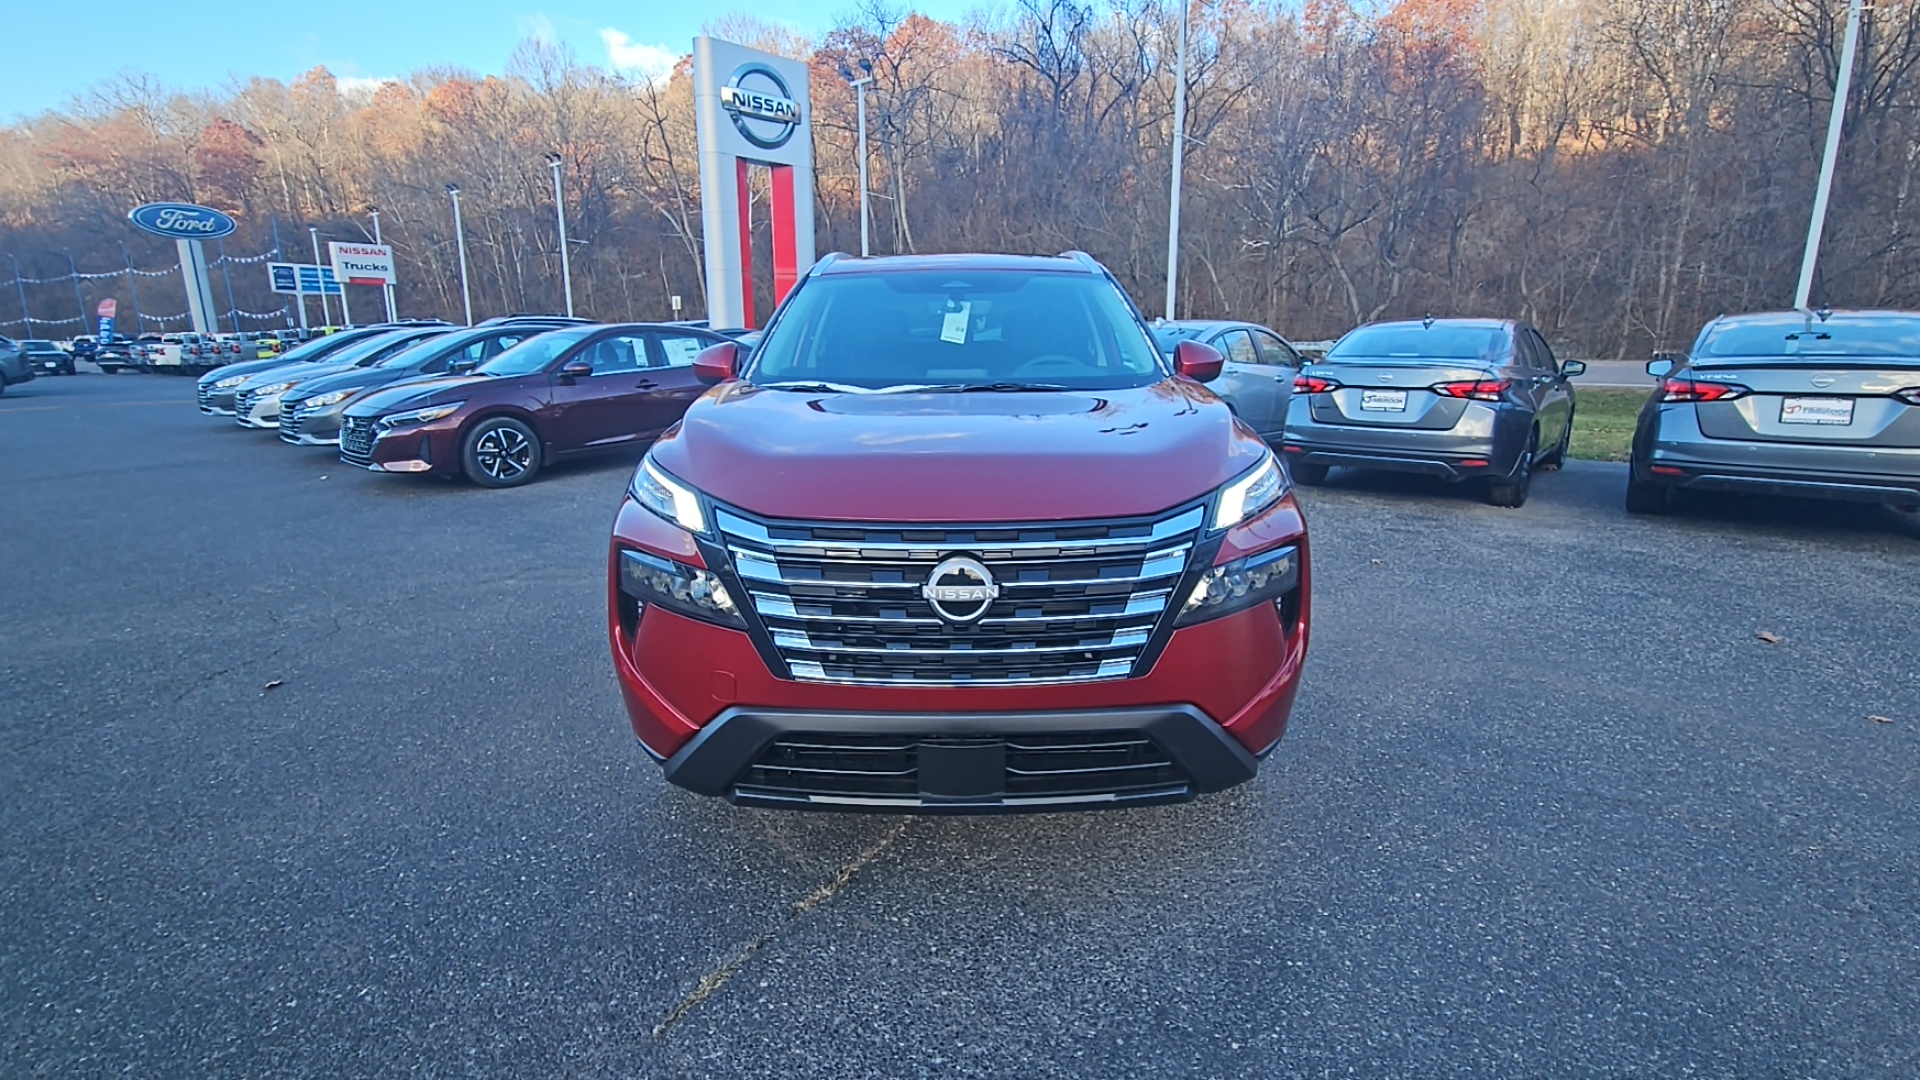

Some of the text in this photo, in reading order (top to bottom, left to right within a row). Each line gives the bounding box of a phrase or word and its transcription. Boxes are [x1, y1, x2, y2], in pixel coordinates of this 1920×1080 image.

[732, 92, 796, 118] NISSAN
[156, 208, 216, 232] Ford
[339, 246, 387, 256] NISSAN
[342, 261, 388, 272] Trucks
[924, 588, 997, 599] NISSAN
